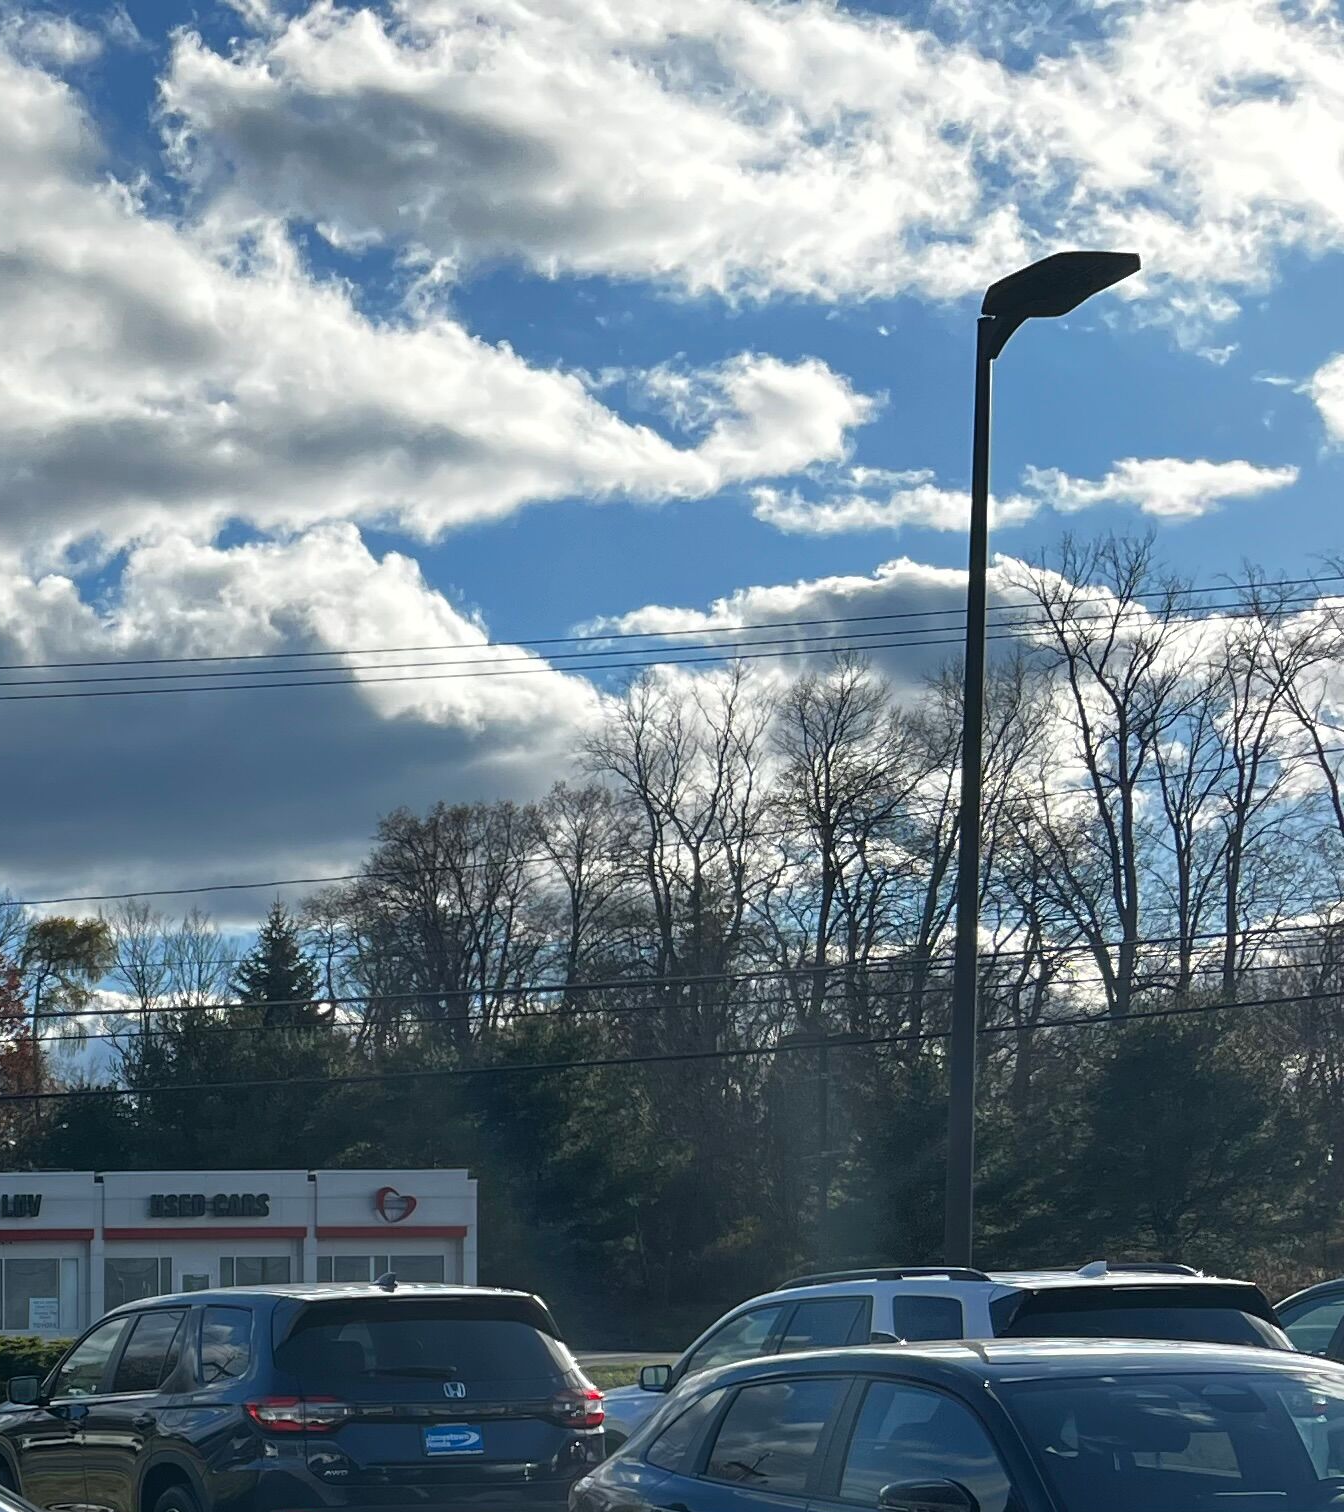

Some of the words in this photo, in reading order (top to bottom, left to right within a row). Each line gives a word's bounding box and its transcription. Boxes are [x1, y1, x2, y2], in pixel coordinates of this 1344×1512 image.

[1, 1194, 42, 1217] LUV
[149, 1194, 206, 1218] USED
[212, 1193, 270, 1217] CARS
